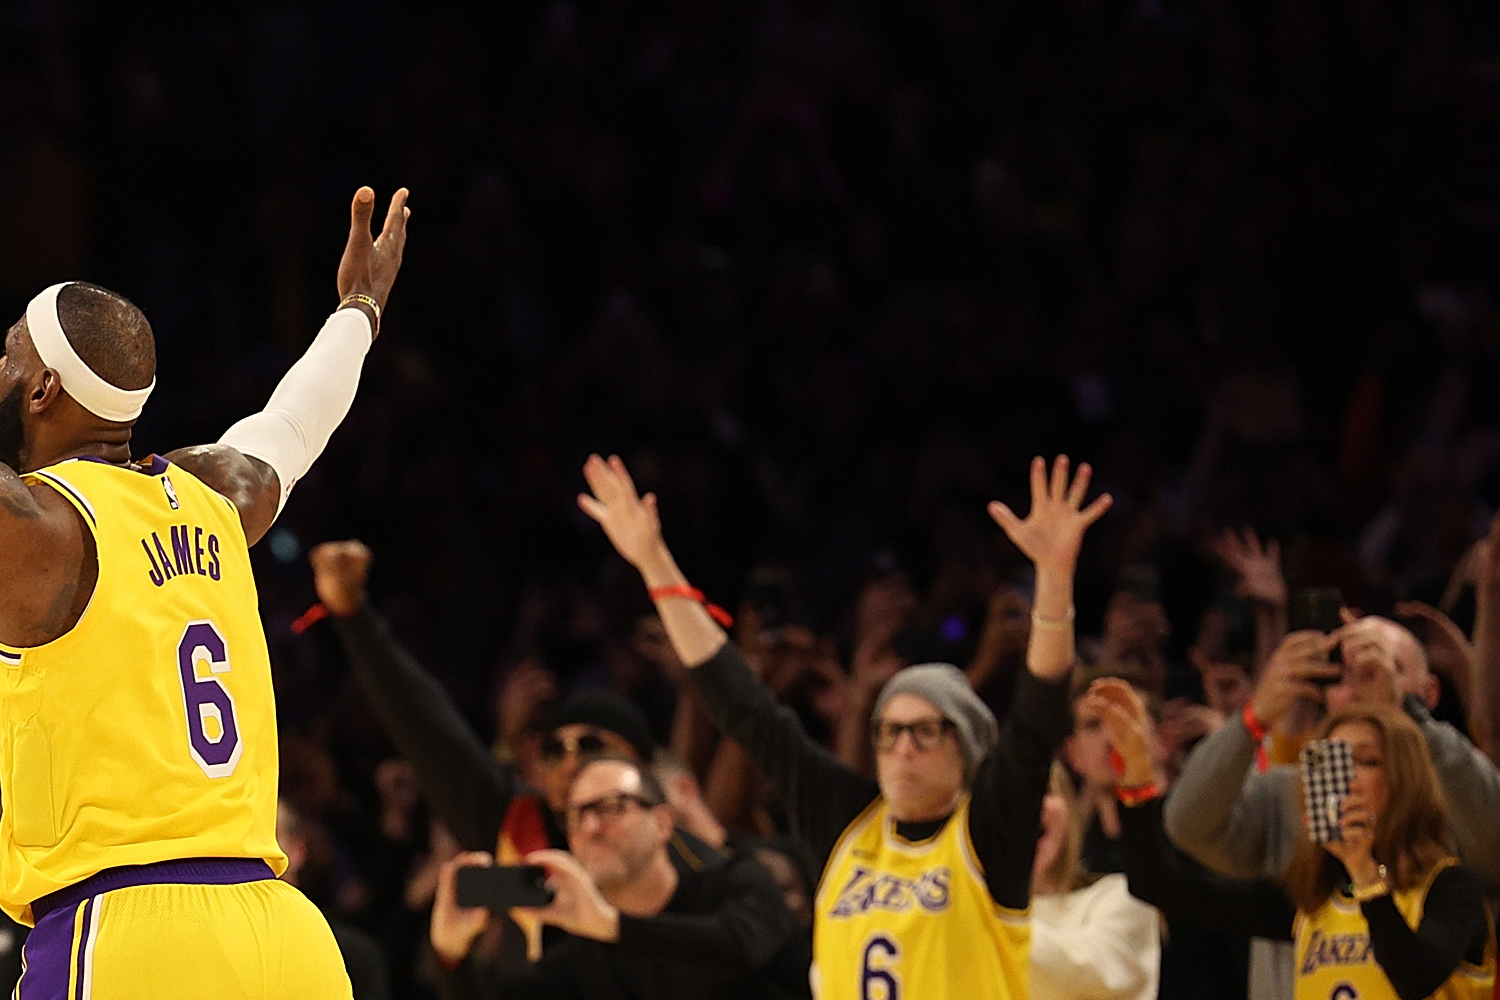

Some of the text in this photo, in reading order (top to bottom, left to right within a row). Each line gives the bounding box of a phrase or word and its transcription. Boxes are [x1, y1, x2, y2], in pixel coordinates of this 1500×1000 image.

[141, 525, 220, 587] JAMES
[177, 618, 243, 779] 6
[830, 864, 953, 920] LAKES
